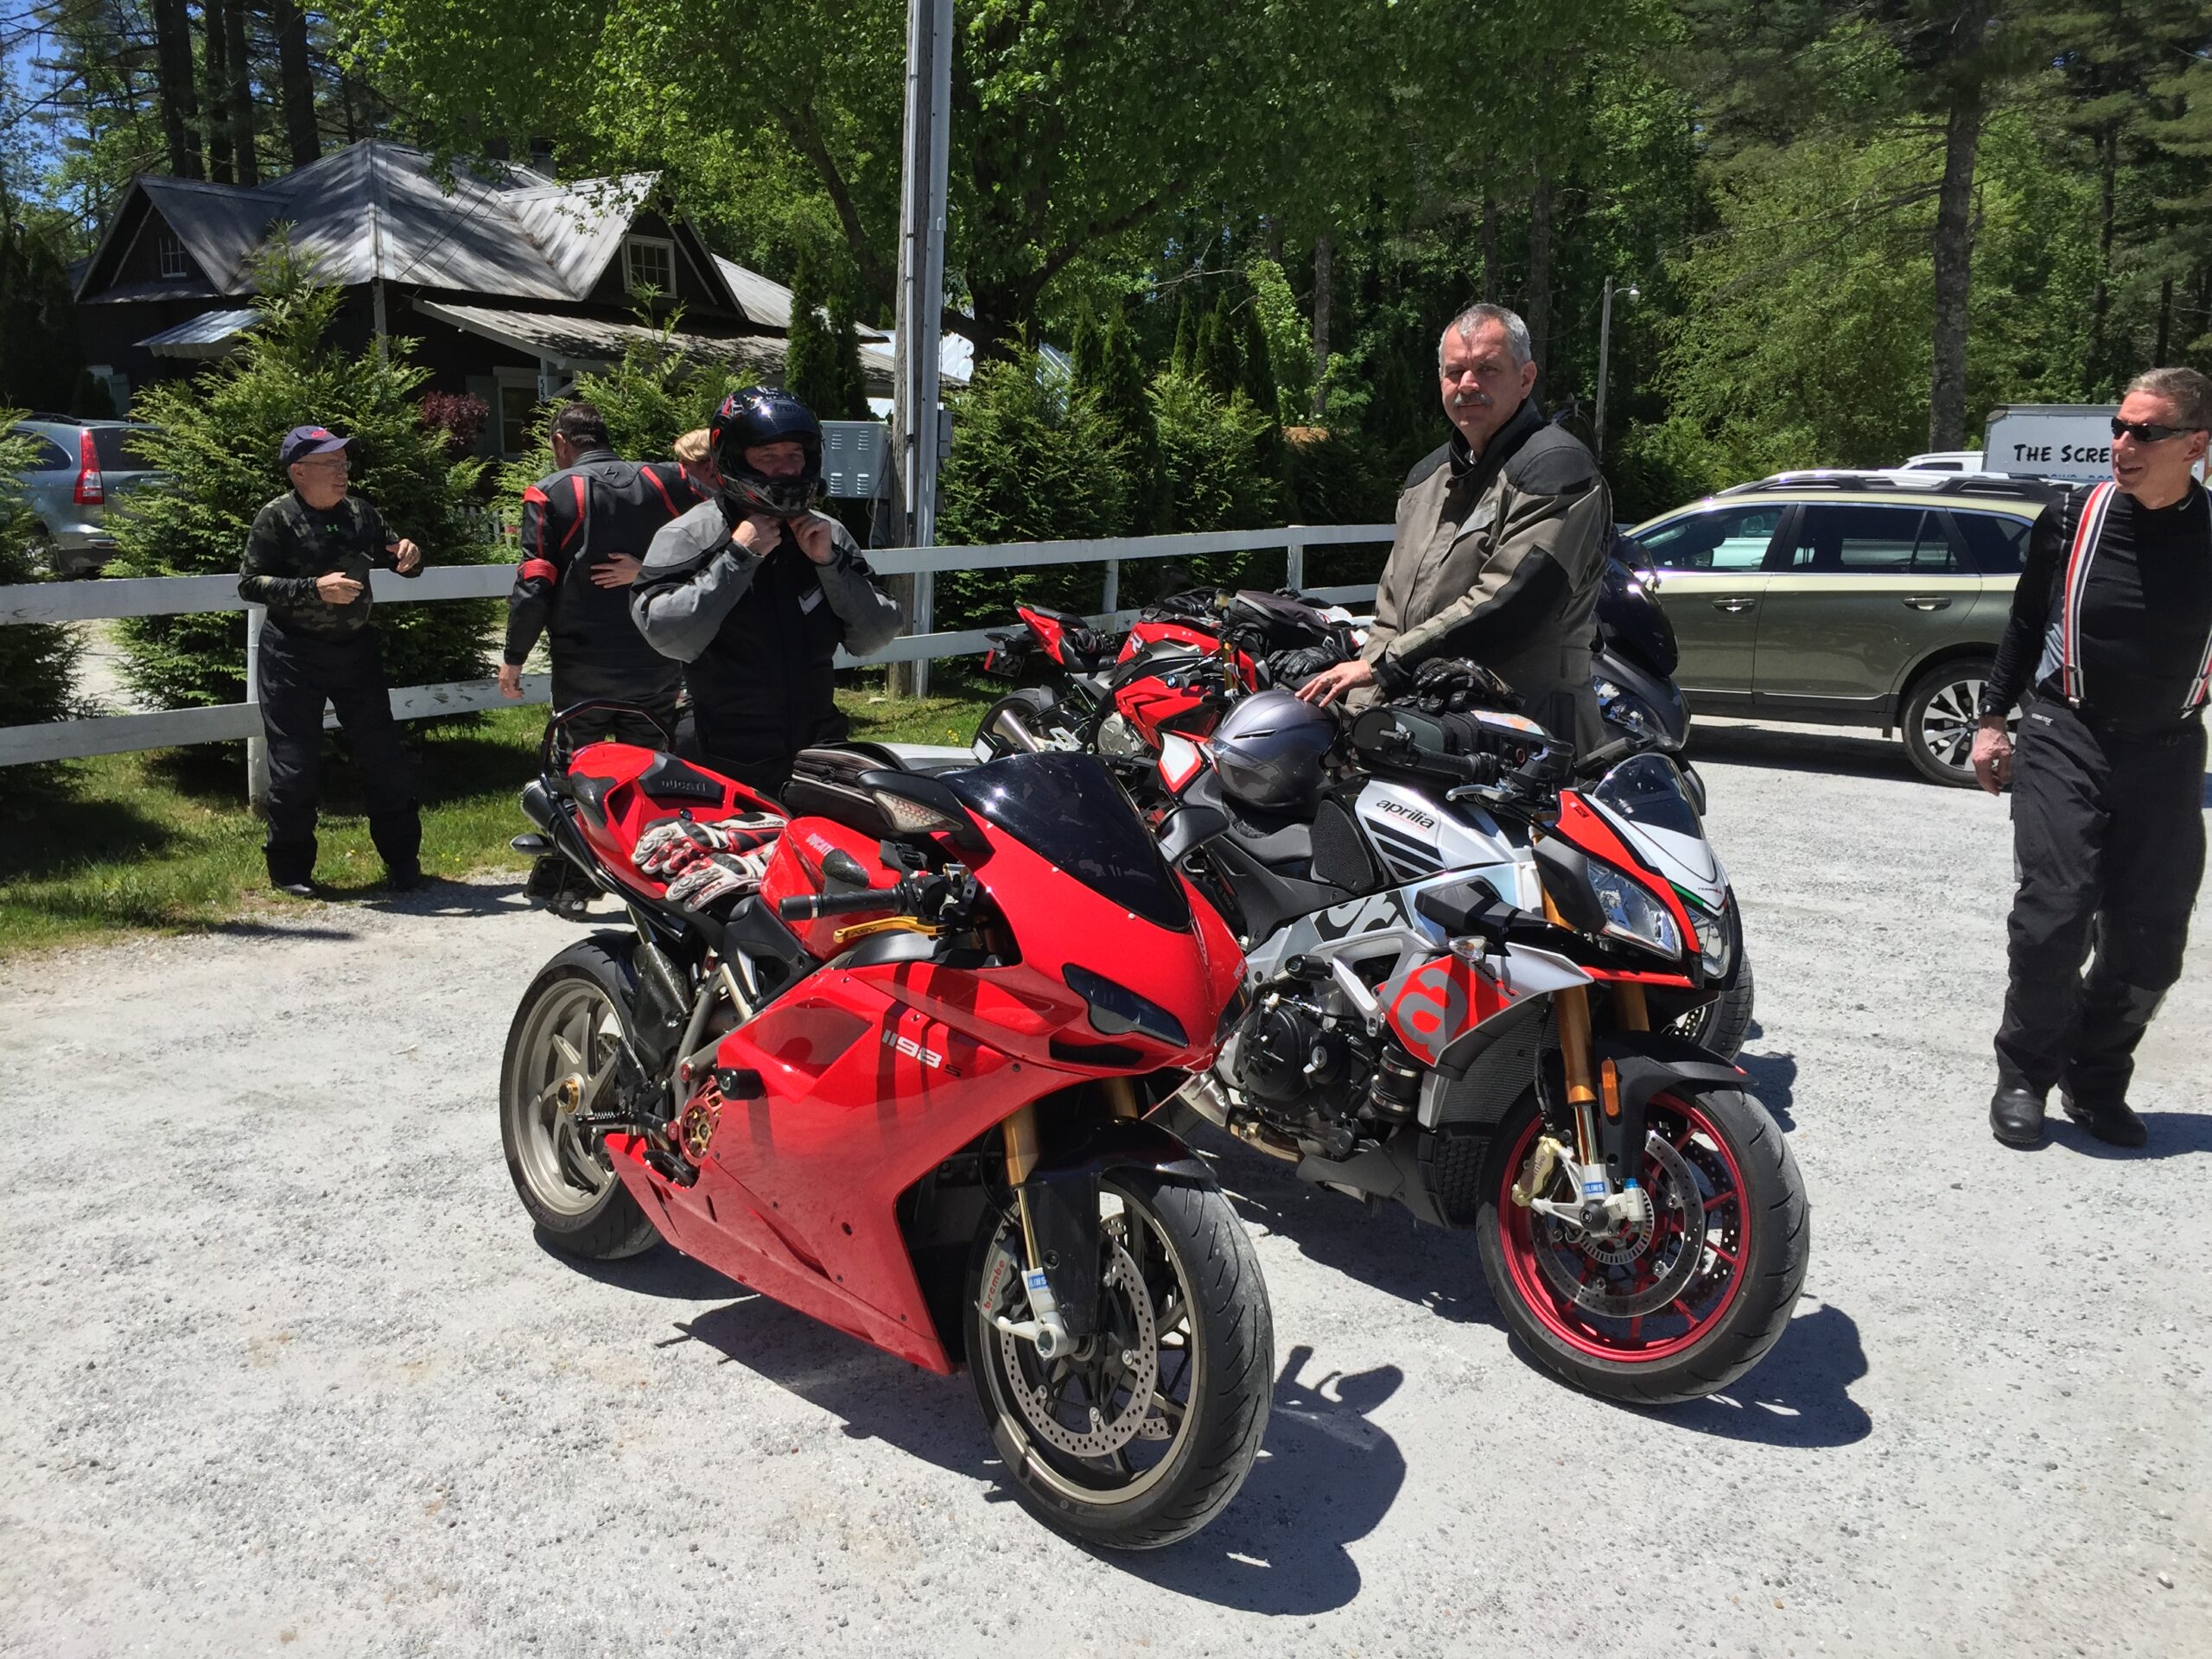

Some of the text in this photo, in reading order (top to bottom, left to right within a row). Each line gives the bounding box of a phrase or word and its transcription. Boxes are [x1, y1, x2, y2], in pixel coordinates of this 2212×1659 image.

[2013, 444, 2110, 464] THE SCRE
[1376, 799, 1435, 830] aprilia
[881, 1029, 943, 1069] 1198
[983, 1260, 1005, 1310] brembo
